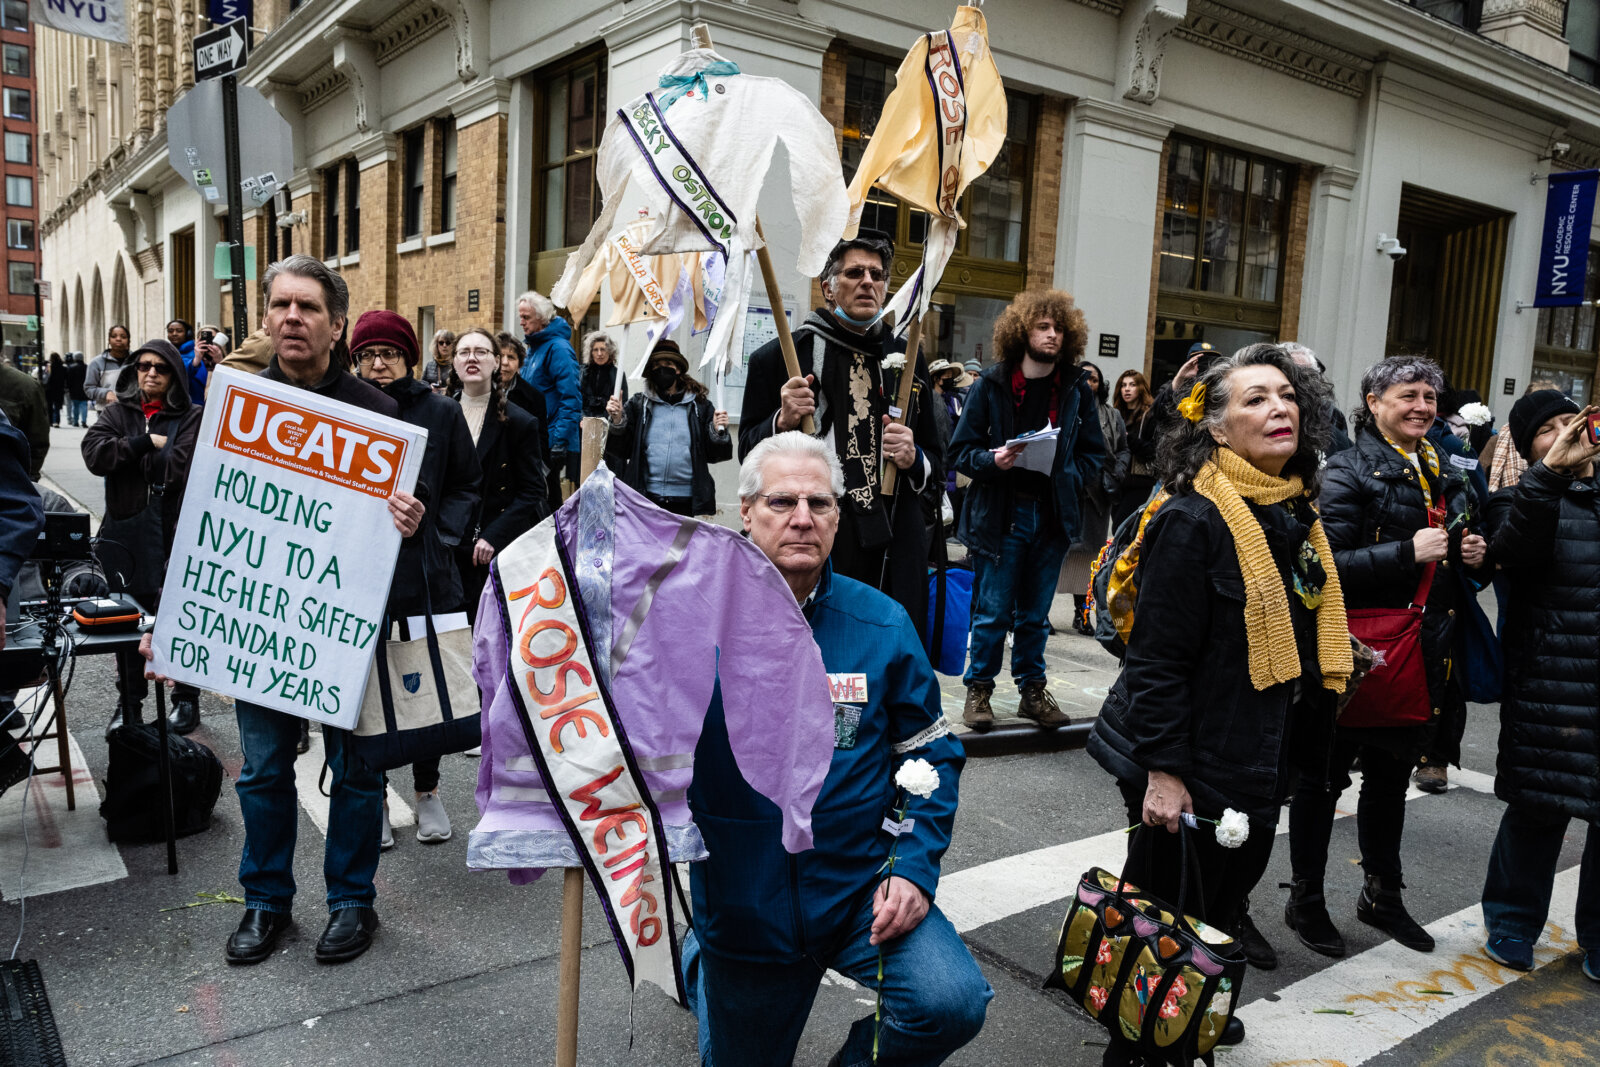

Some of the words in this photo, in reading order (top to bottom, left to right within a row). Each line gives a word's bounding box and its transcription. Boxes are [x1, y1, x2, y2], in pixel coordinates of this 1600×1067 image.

[48, 0, 106, 23] NYU
[199, 46, 214, 68] ONE
[217, 38, 232, 62] WAY
[632, 102, 670, 155] BECKY
[929, 44, 965, 145] ROSE
[1555, 216, 1566, 254] ACADEMIC
[1563, 214, 1575, 254] RESOURCE
[1569, 184, 1580, 214] CENTER
[1551, 255, 1569, 295] NYU
[223, 441, 242, 451] Union
[250, 449, 274, 462] Clerical,
[275, 457, 318, 475] Administrative
[324, 472, 351, 485] Technical
[352, 480, 367, 490] Staff
[373, 487, 388, 496] NYU
[228, 395, 397, 484] UCATS
[284, 439, 301, 447] AFL-CIO
[214, 464, 333, 533] HOLDING
[197, 511, 266, 569] NYU
[286, 541, 314, 580] TO
[317, 555, 341, 589] A
[178, 600, 317, 670] STANDARD
[182, 555, 290, 623] HIGHER
[299, 596, 377, 649] SAFETY
[170, 637, 210, 675] FOR
[226, 655, 257, 689] 44
[261, 666, 341, 715] YEARS
[508, 566, 611, 754] ROSIE
[827, 677, 865, 701] WE
